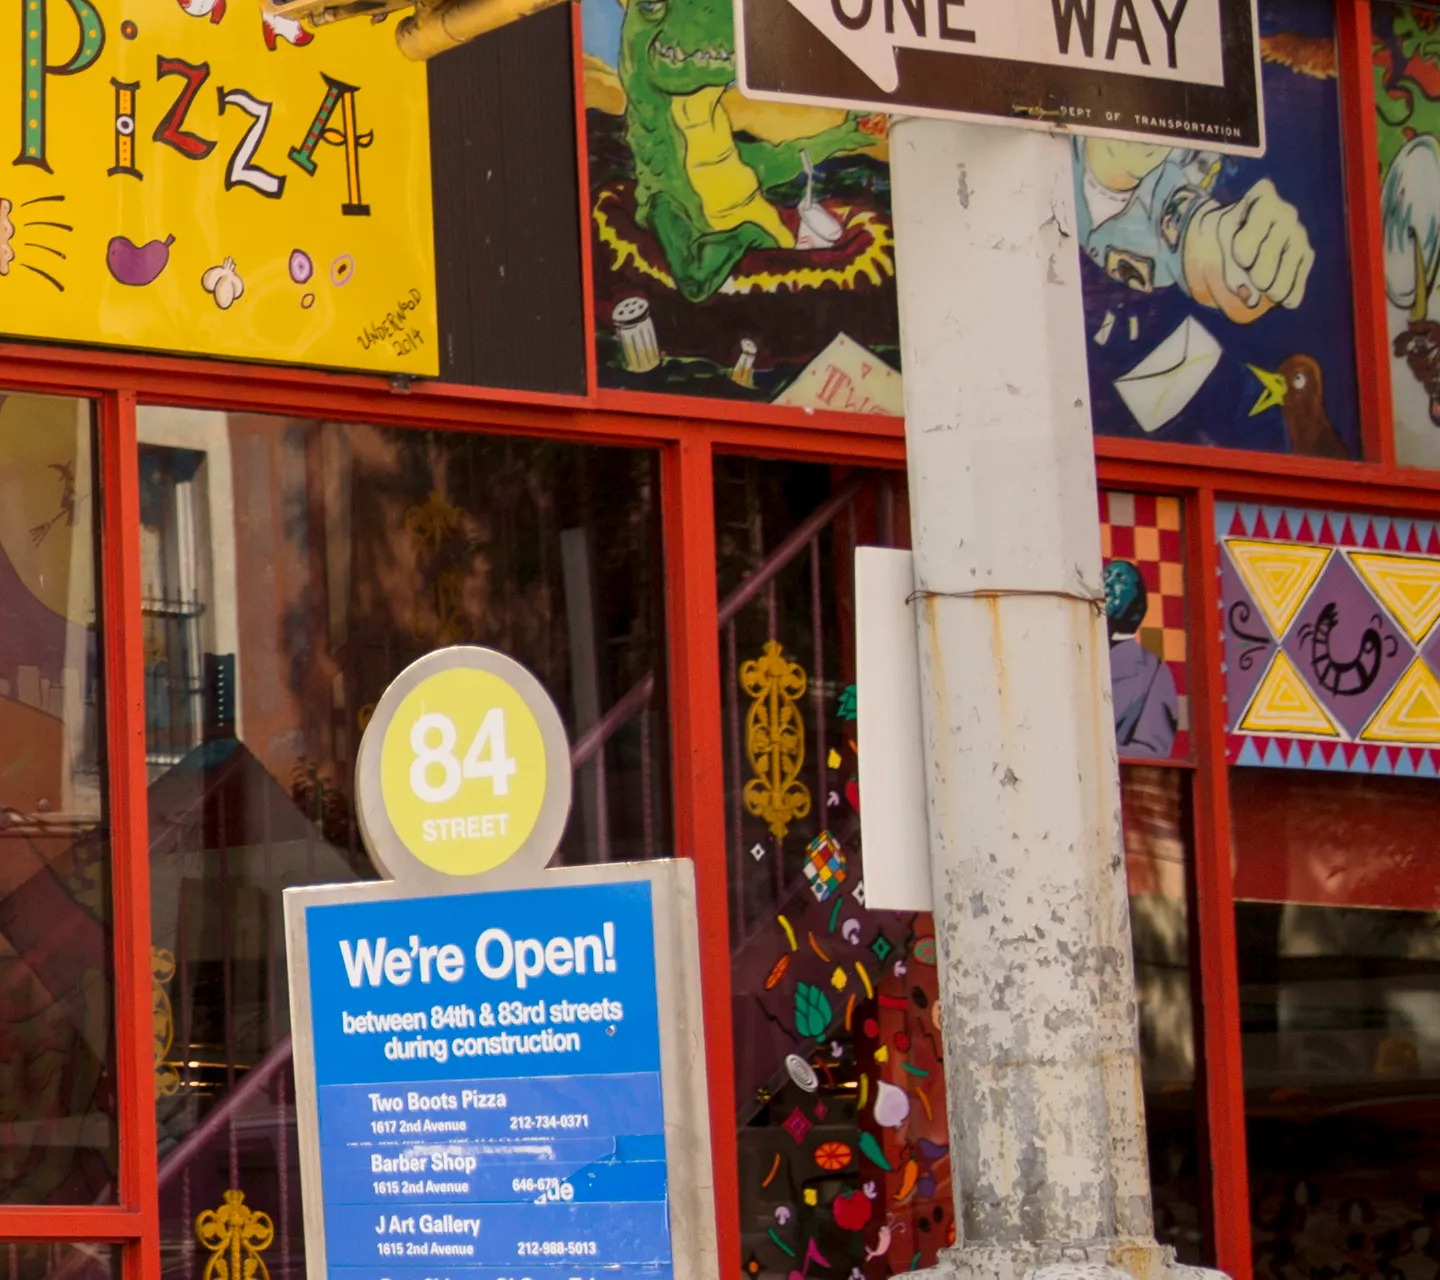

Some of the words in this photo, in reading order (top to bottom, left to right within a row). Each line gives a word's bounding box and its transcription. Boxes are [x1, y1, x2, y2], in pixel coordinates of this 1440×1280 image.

[1106, 111, 1121, 121] OF
[1134, 114, 1242, 138] TRANSPORTATION
[409, 707, 516, 804] 84
[421, 812, 510, 843] STREET
[339, 934, 465, 988] We're
[475, 921, 617, 989] Open!
[342, 1010, 426, 1034] between
[430, 1004, 475, 1030] 84th
[479, 1002, 495, 1026] &
[497, 1000, 545, 1025] 83rd
[549, 997, 623, 1022] streets
[384, 1035, 448, 1063] during
[452, 1028, 581, 1056] construction
[368, 1092, 403, 1112] Two
[408, 1091, 457, 1111] Boots
[462, 1089, 506, 1109] Pizza
[371, 1121, 397, 1134] 1617
[399, 1120, 421, 1133] 2nd
[422, 1119, 467, 1132] Avenue
[509, 1114, 589, 1130] 212-734-0371
[371, 1153, 428, 1173] Barber
[431, 1151, 477, 1175] Shop
[373, 1181, 399, 1195] 1615
[401, 1180, 423, 1194] 2nd
[425, 1180, 469, 1193] Avenue
[375, 1216, 385, 1235] J
[389, 1216, 415, 1234] Art
[419, 1215, 481, 1238] Gallery
[378, 1243, 404, 1256] 1615
[406, 1242, 428, 1256] 2nd
[430, 1242, 474, 1255] Avenue
[517, 1241, 596, 1256] 212-988-5013
